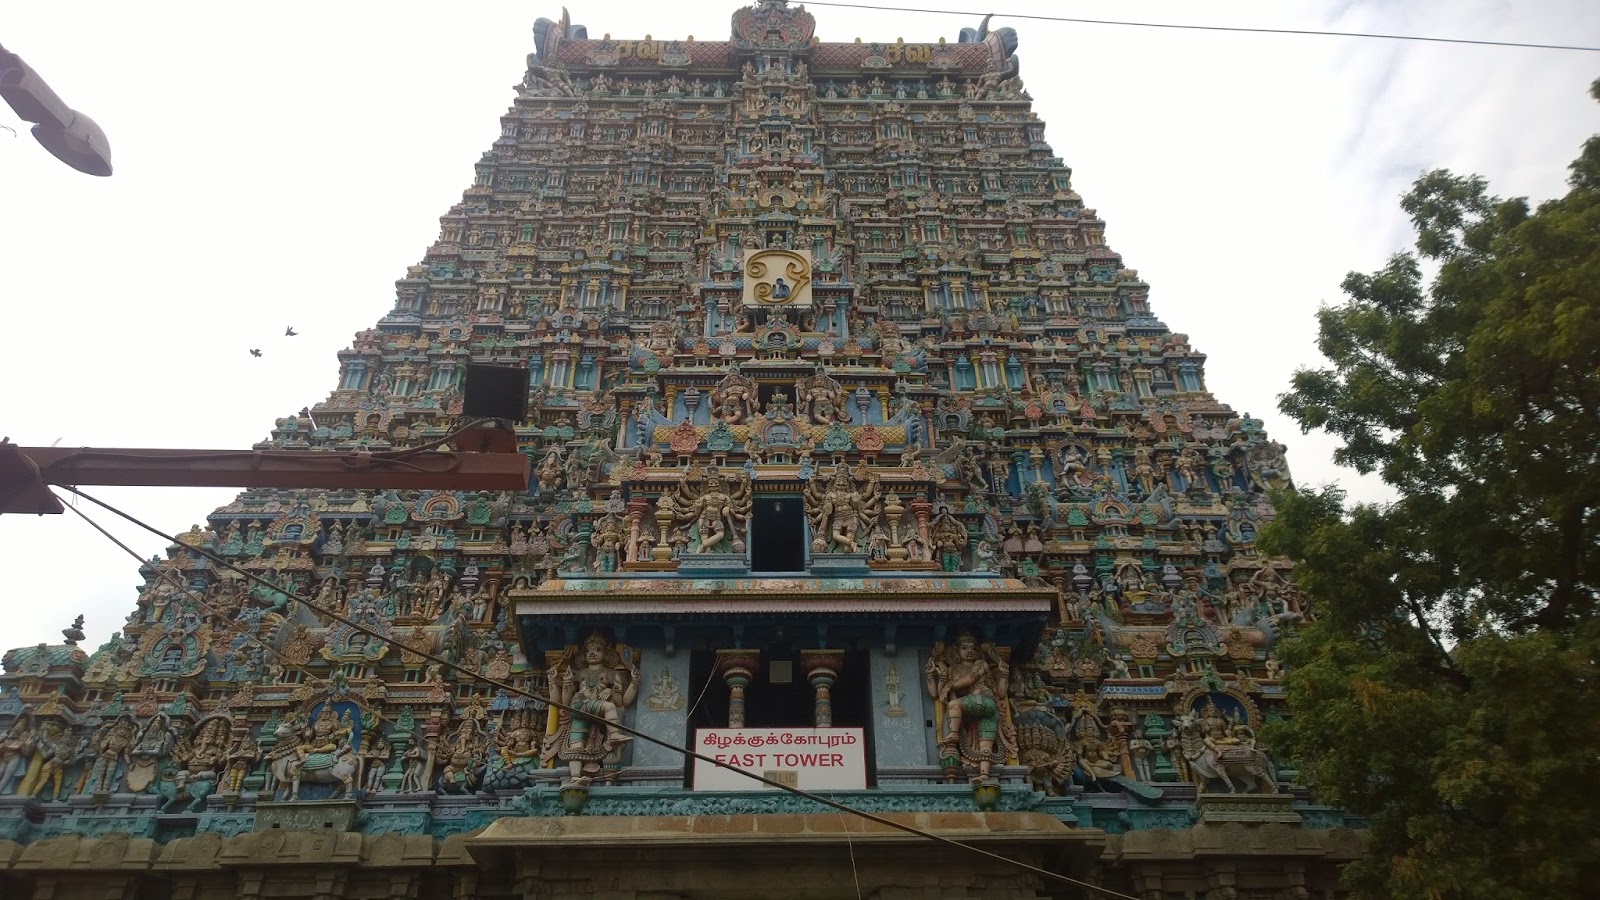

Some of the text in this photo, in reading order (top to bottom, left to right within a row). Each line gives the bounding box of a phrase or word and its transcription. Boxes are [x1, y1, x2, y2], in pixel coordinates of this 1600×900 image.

[703, 732, 856, 749] கிழக்குக்கோபுரம்
[715, 753, 844, 767] EAST TOWER
[778, 772, 795, 784] LIC
